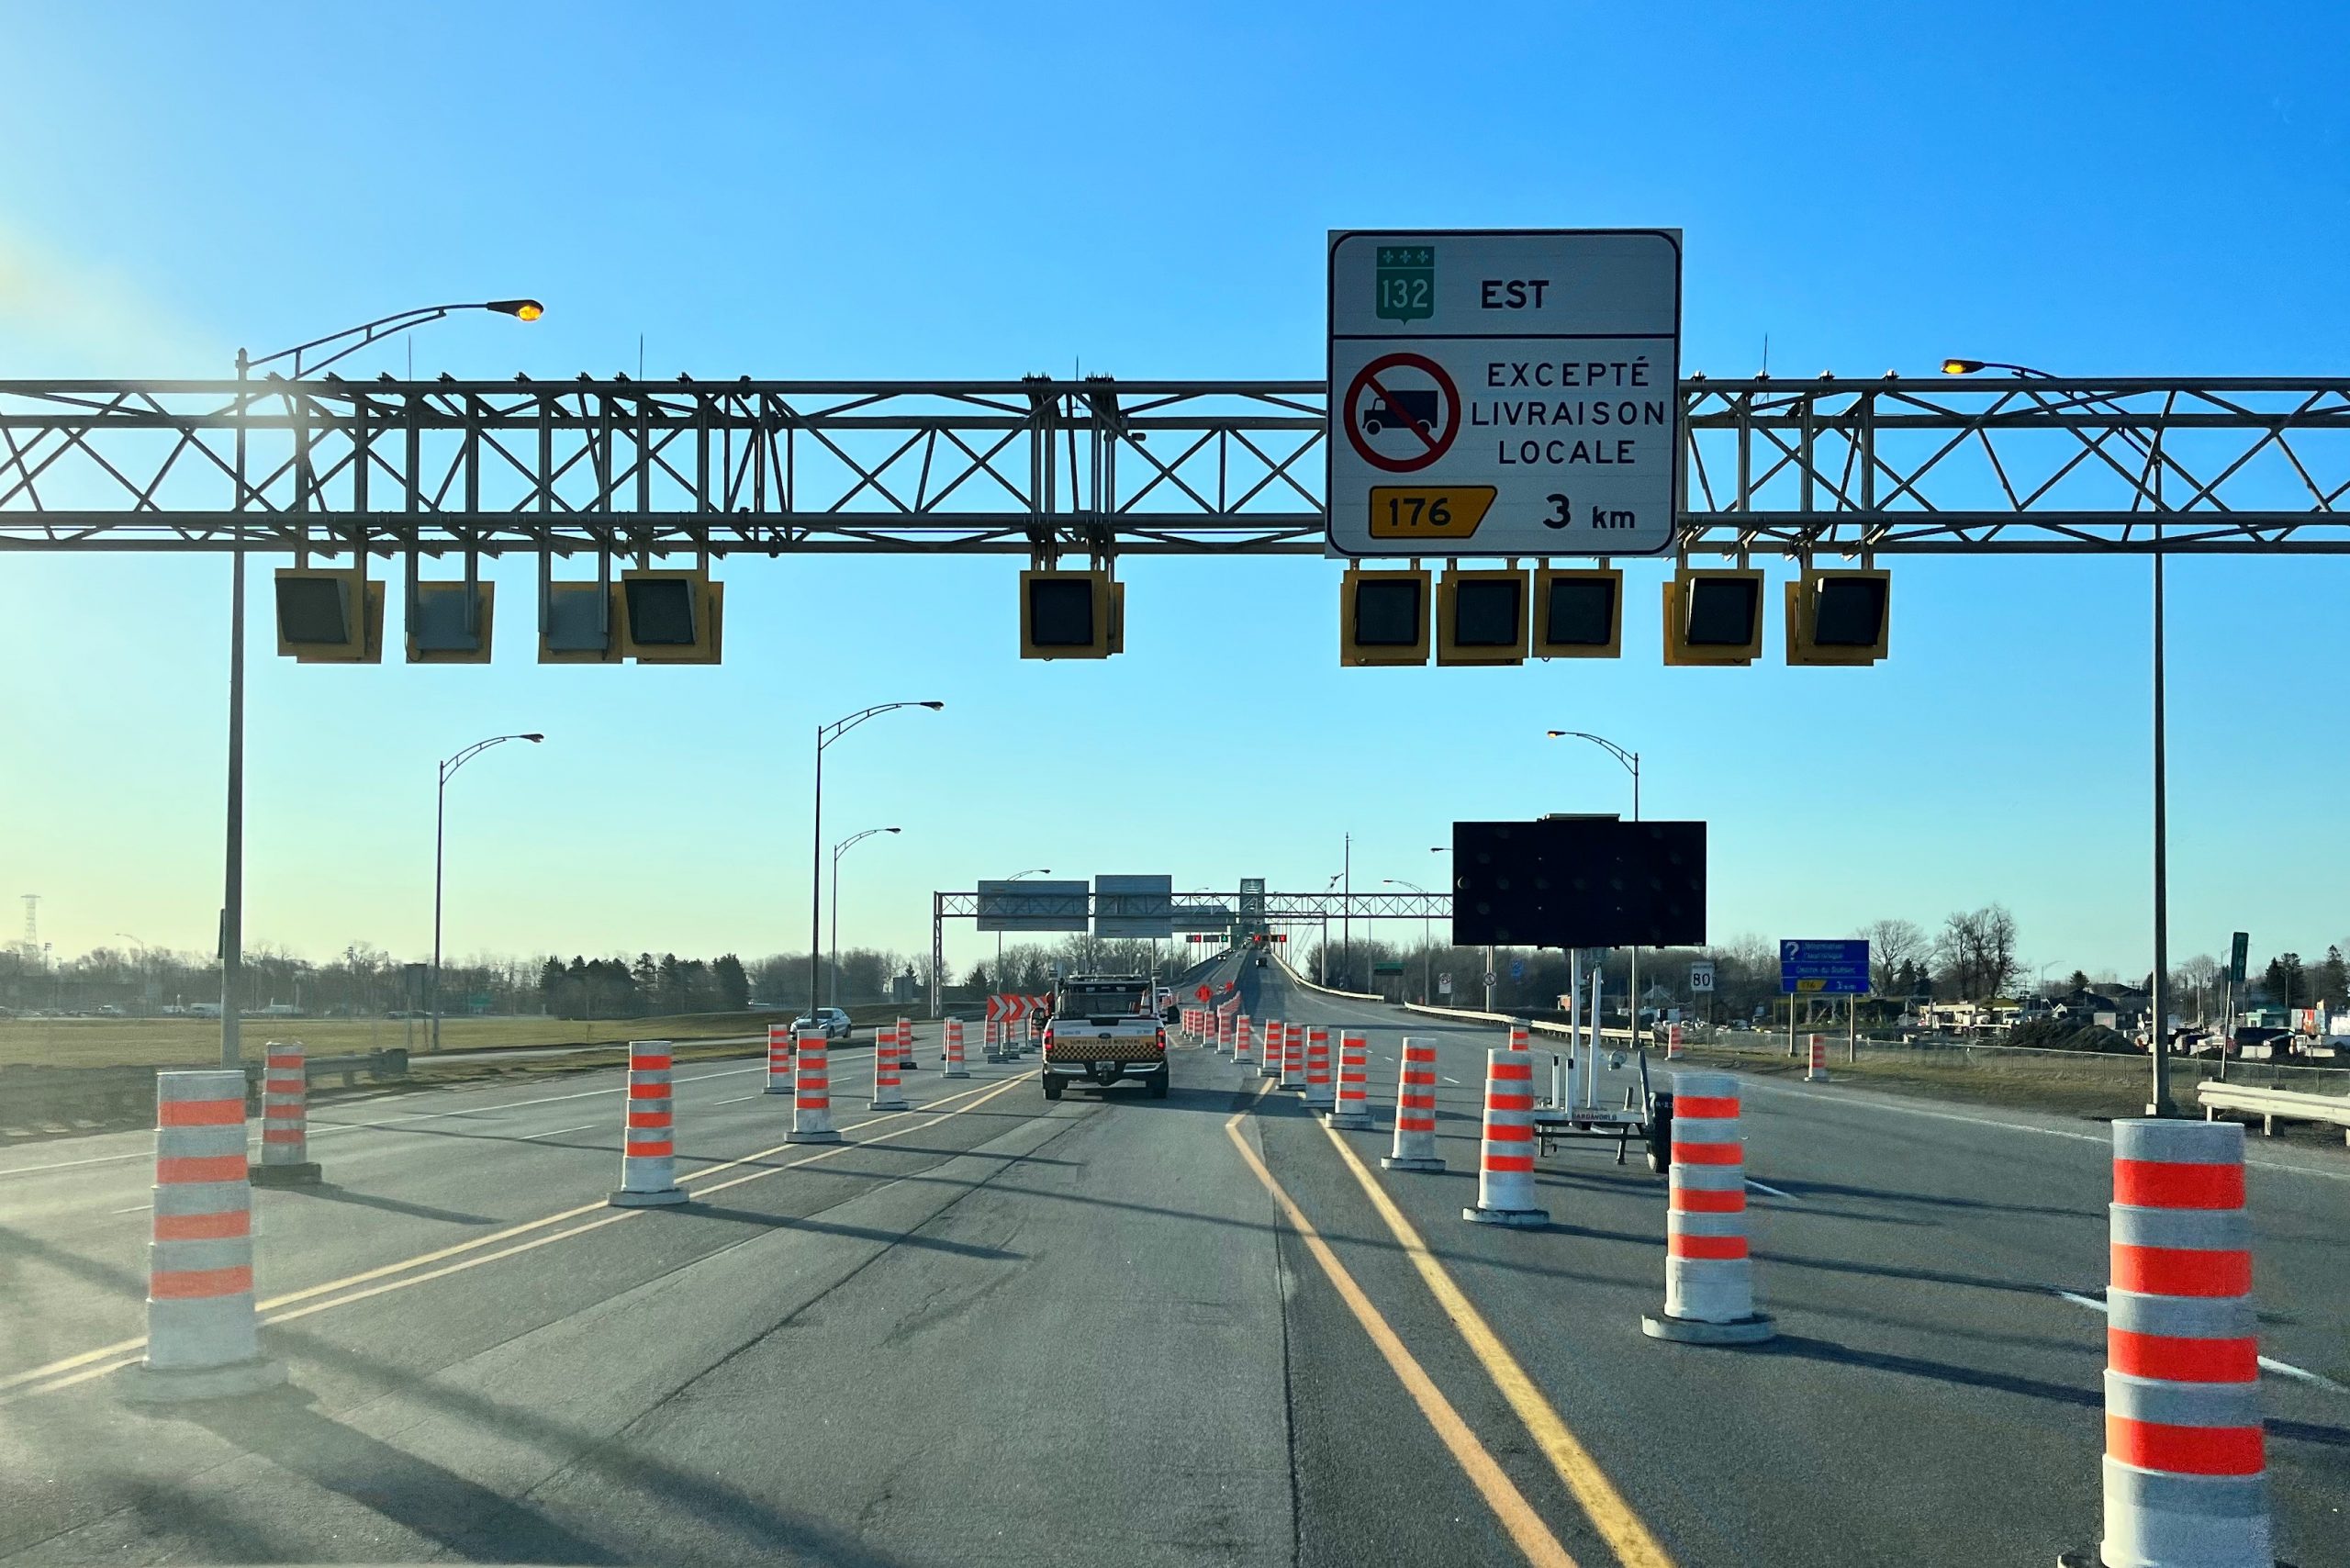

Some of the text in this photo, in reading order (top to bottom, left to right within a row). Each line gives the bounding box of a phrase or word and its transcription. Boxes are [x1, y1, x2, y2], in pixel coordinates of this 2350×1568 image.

[1382, 278, 1428, 308] 132
[1481, 280, 1550, 308] EST
[1487, 355, 1650, 386] EXCEPTÉ
[1472, 400, 1664, 426] LIVRAISON
[1498, 440, 1636, 465] LOCALE
[1389, 497, 1452, 527] 176
[1542, 493, 1636, 530] 3 km
[1693, 973, 1710, 987] 80
